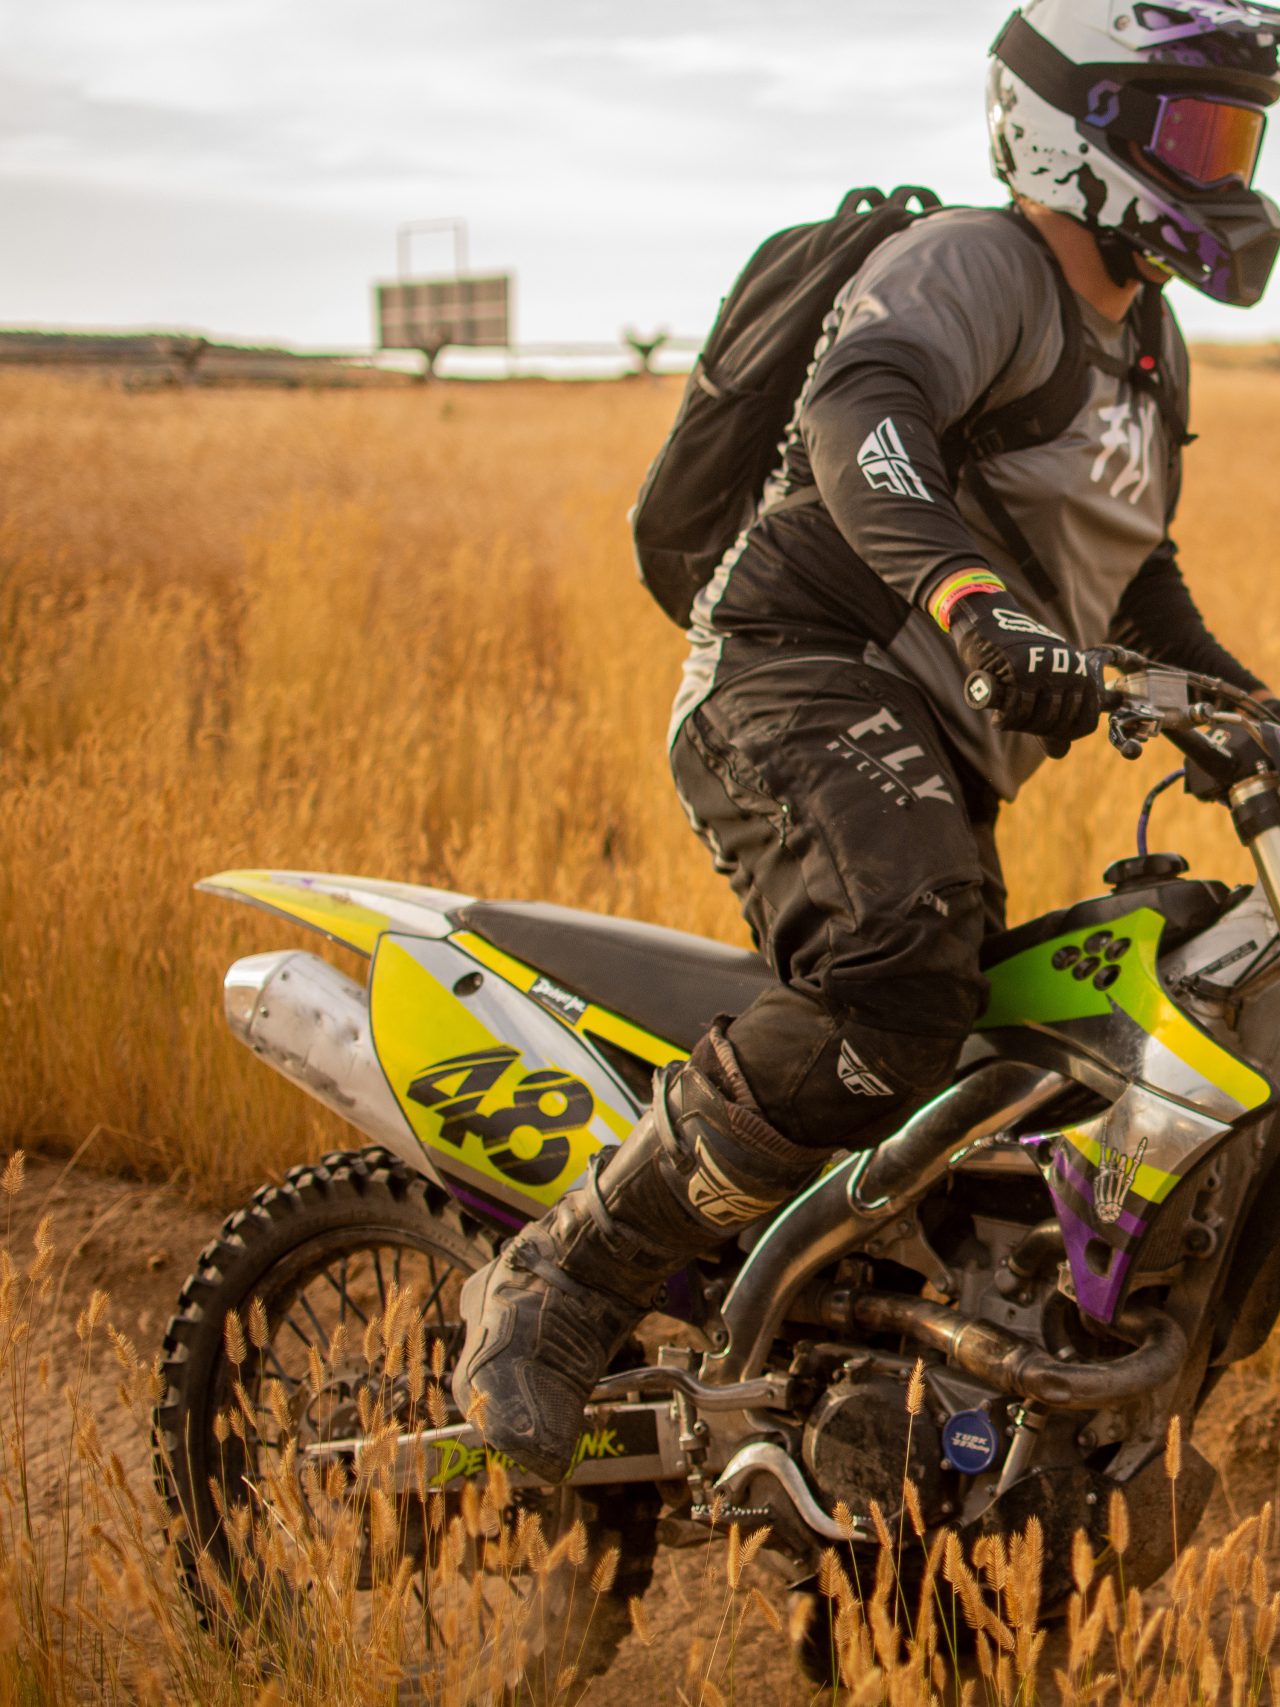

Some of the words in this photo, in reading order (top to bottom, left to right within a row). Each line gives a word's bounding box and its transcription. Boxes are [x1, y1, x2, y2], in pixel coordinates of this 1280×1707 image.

[1090, 398, 1156, 504] FLY
[1028, 647, 1088, 677] FOX
[825, 741, 908, 806] RACING
[847, 706, 955, 804] FLY
[406, 1044, 595, 1187] 48
